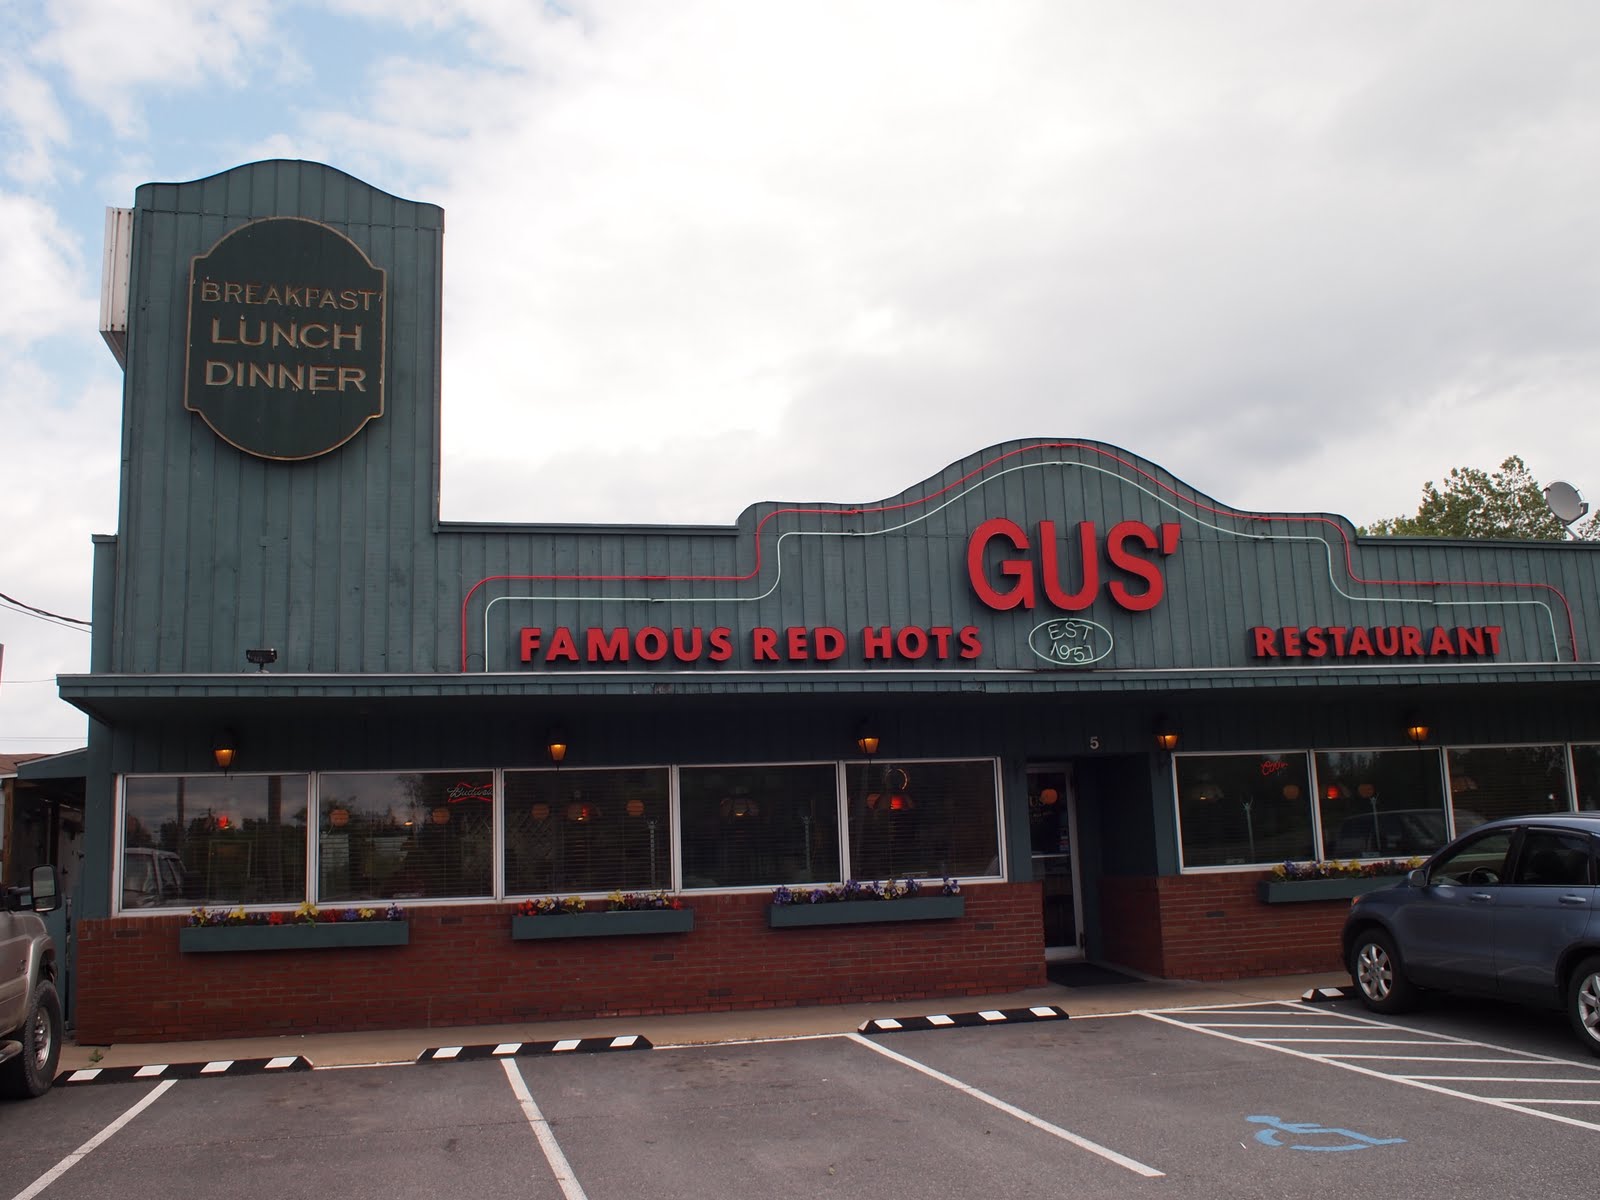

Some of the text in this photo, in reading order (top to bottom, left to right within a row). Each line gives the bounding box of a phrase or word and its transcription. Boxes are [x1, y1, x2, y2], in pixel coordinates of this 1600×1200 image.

[201, 281, 376, 311] BREAKFAST
[211, 318, 363, 351] LUNCH
[205, 359, 367, 392] DINNER
[520, 626, 983, 662] FAMOUS RED HOTS
[1048, 622, 1093, 640] EST
[1254, 626, 1502, 658] RESTAURANT
[1050, 642, 1094, 662] 1951
[1089, 736, 1100, 750] 5
